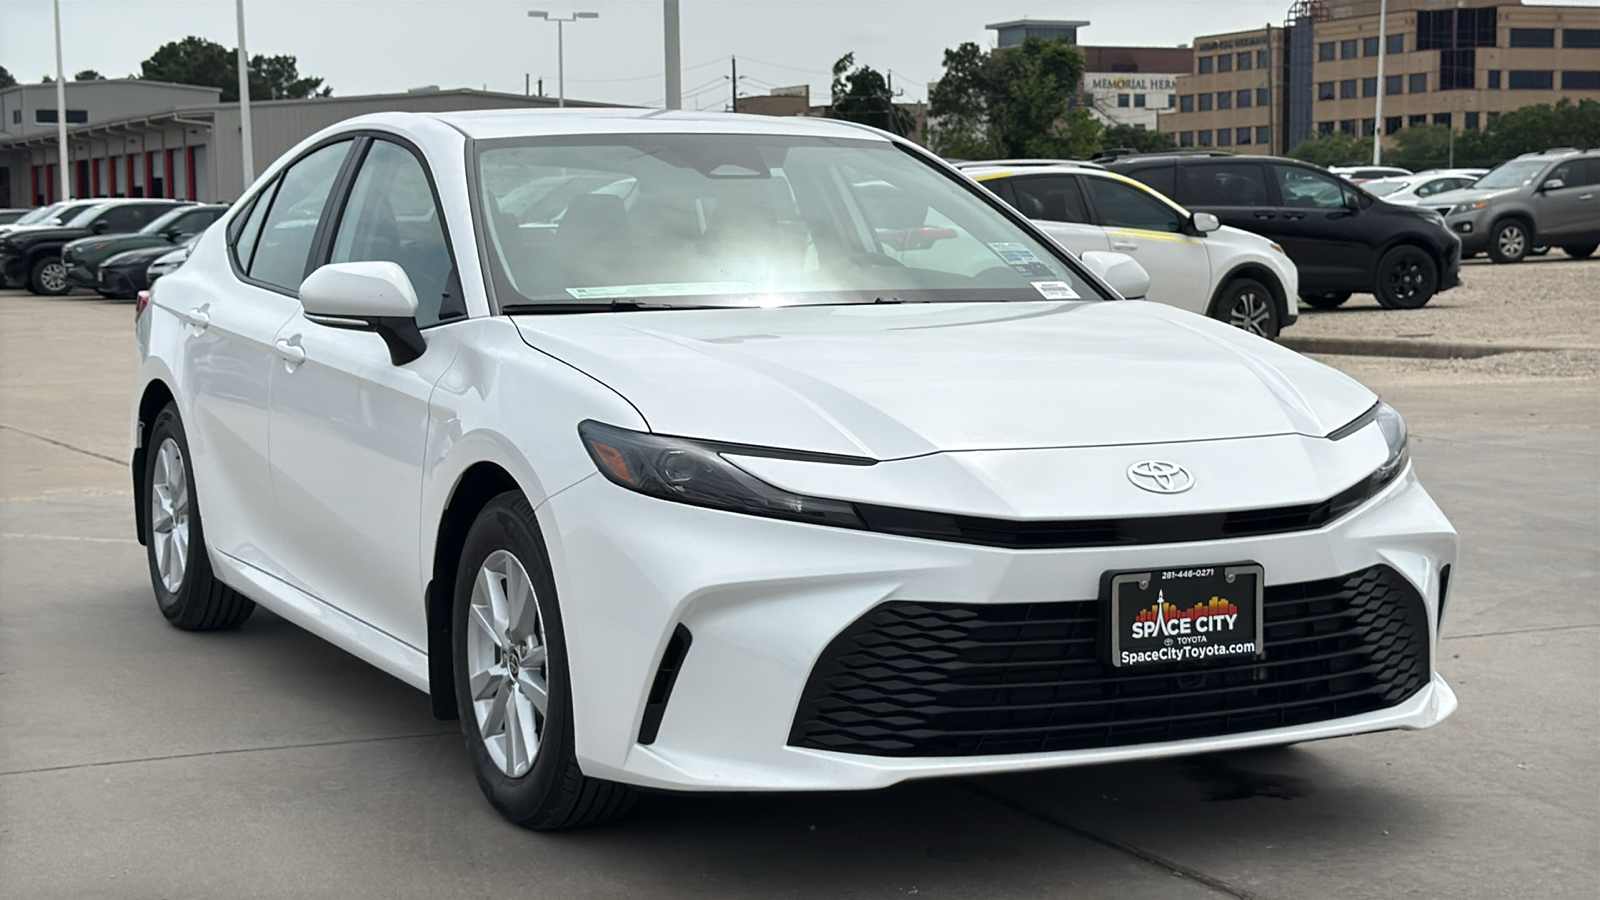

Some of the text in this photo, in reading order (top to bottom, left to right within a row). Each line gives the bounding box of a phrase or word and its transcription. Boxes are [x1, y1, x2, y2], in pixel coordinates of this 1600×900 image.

[1092, 78, 1147, 90] MEMORIAL
[1161, 568, 1214, 579] 281-446-0271
[1131, 611, 1238, 638] SPACE CITY
[1177, 635, 1207, 645] TOYOTA
[1121, 642, 1255, 665] SpaceCityToyota.com
